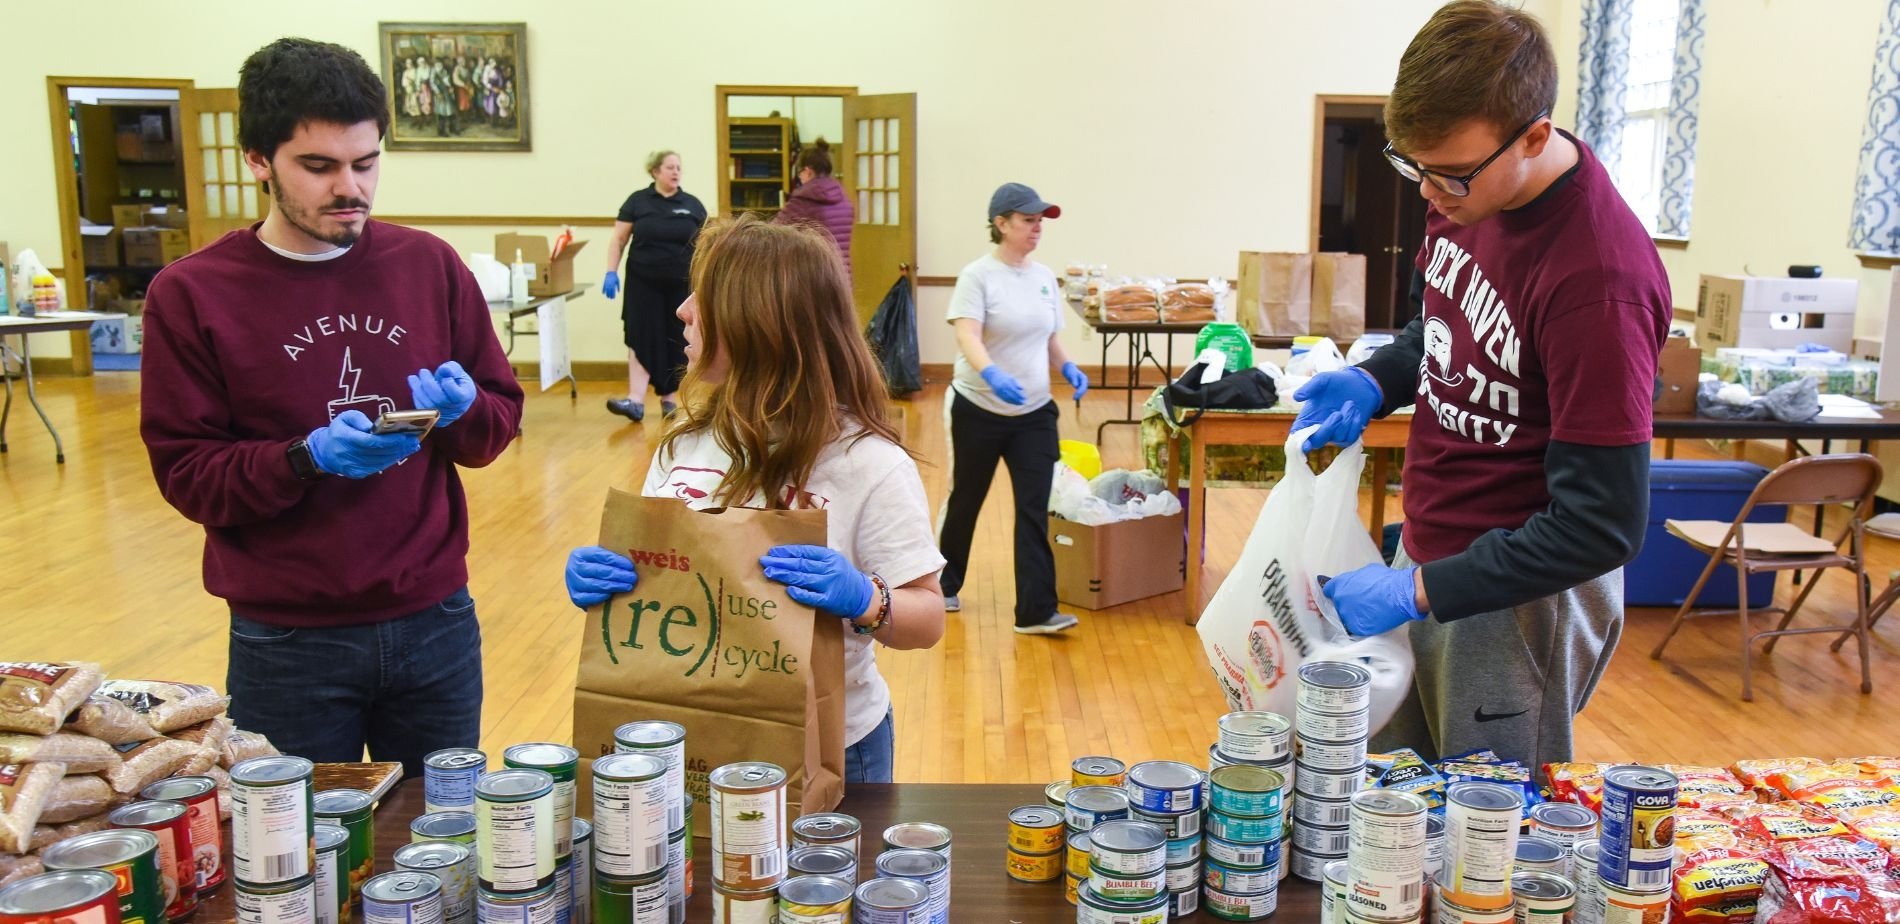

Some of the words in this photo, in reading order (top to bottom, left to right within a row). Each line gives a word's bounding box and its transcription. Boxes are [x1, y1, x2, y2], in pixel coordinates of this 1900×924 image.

[1460, 263, 1521, 379] HAVEN
[283, 313, 407, 361] AVENUE
[628, 549, 690, 572] weis
[728, 594, 778, 620] use
[724, 640, 798, 678] cycle
[685, 757, 707, 772] AG
[1636, 796, 1669, 806] GOYA
[1105, 880, 1139, 888] BUMBLE
[1349, 893, 1387, 911] SEASONED
